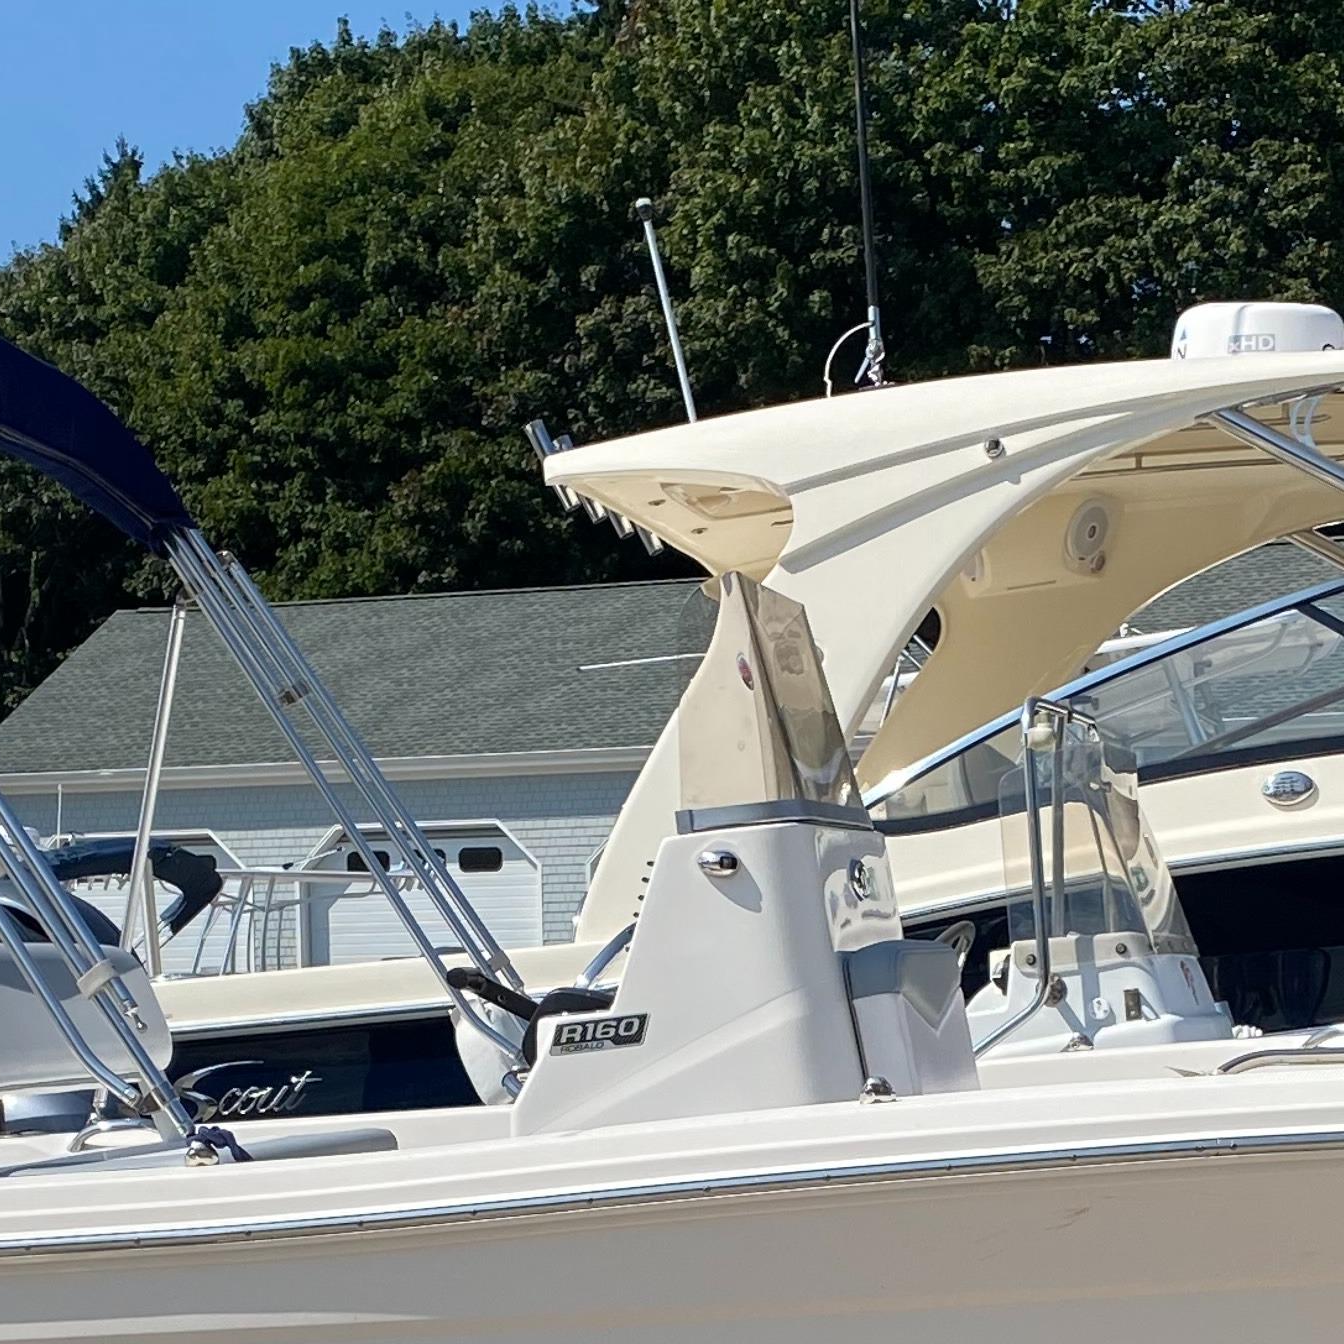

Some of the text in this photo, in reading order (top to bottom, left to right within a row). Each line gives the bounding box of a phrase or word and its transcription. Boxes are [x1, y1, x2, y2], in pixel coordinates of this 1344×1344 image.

[1229, 335, 1274, 353] xHD
[560, 1018, 640, 1043] R160
[174, 1060, 323, 1122] Scout
